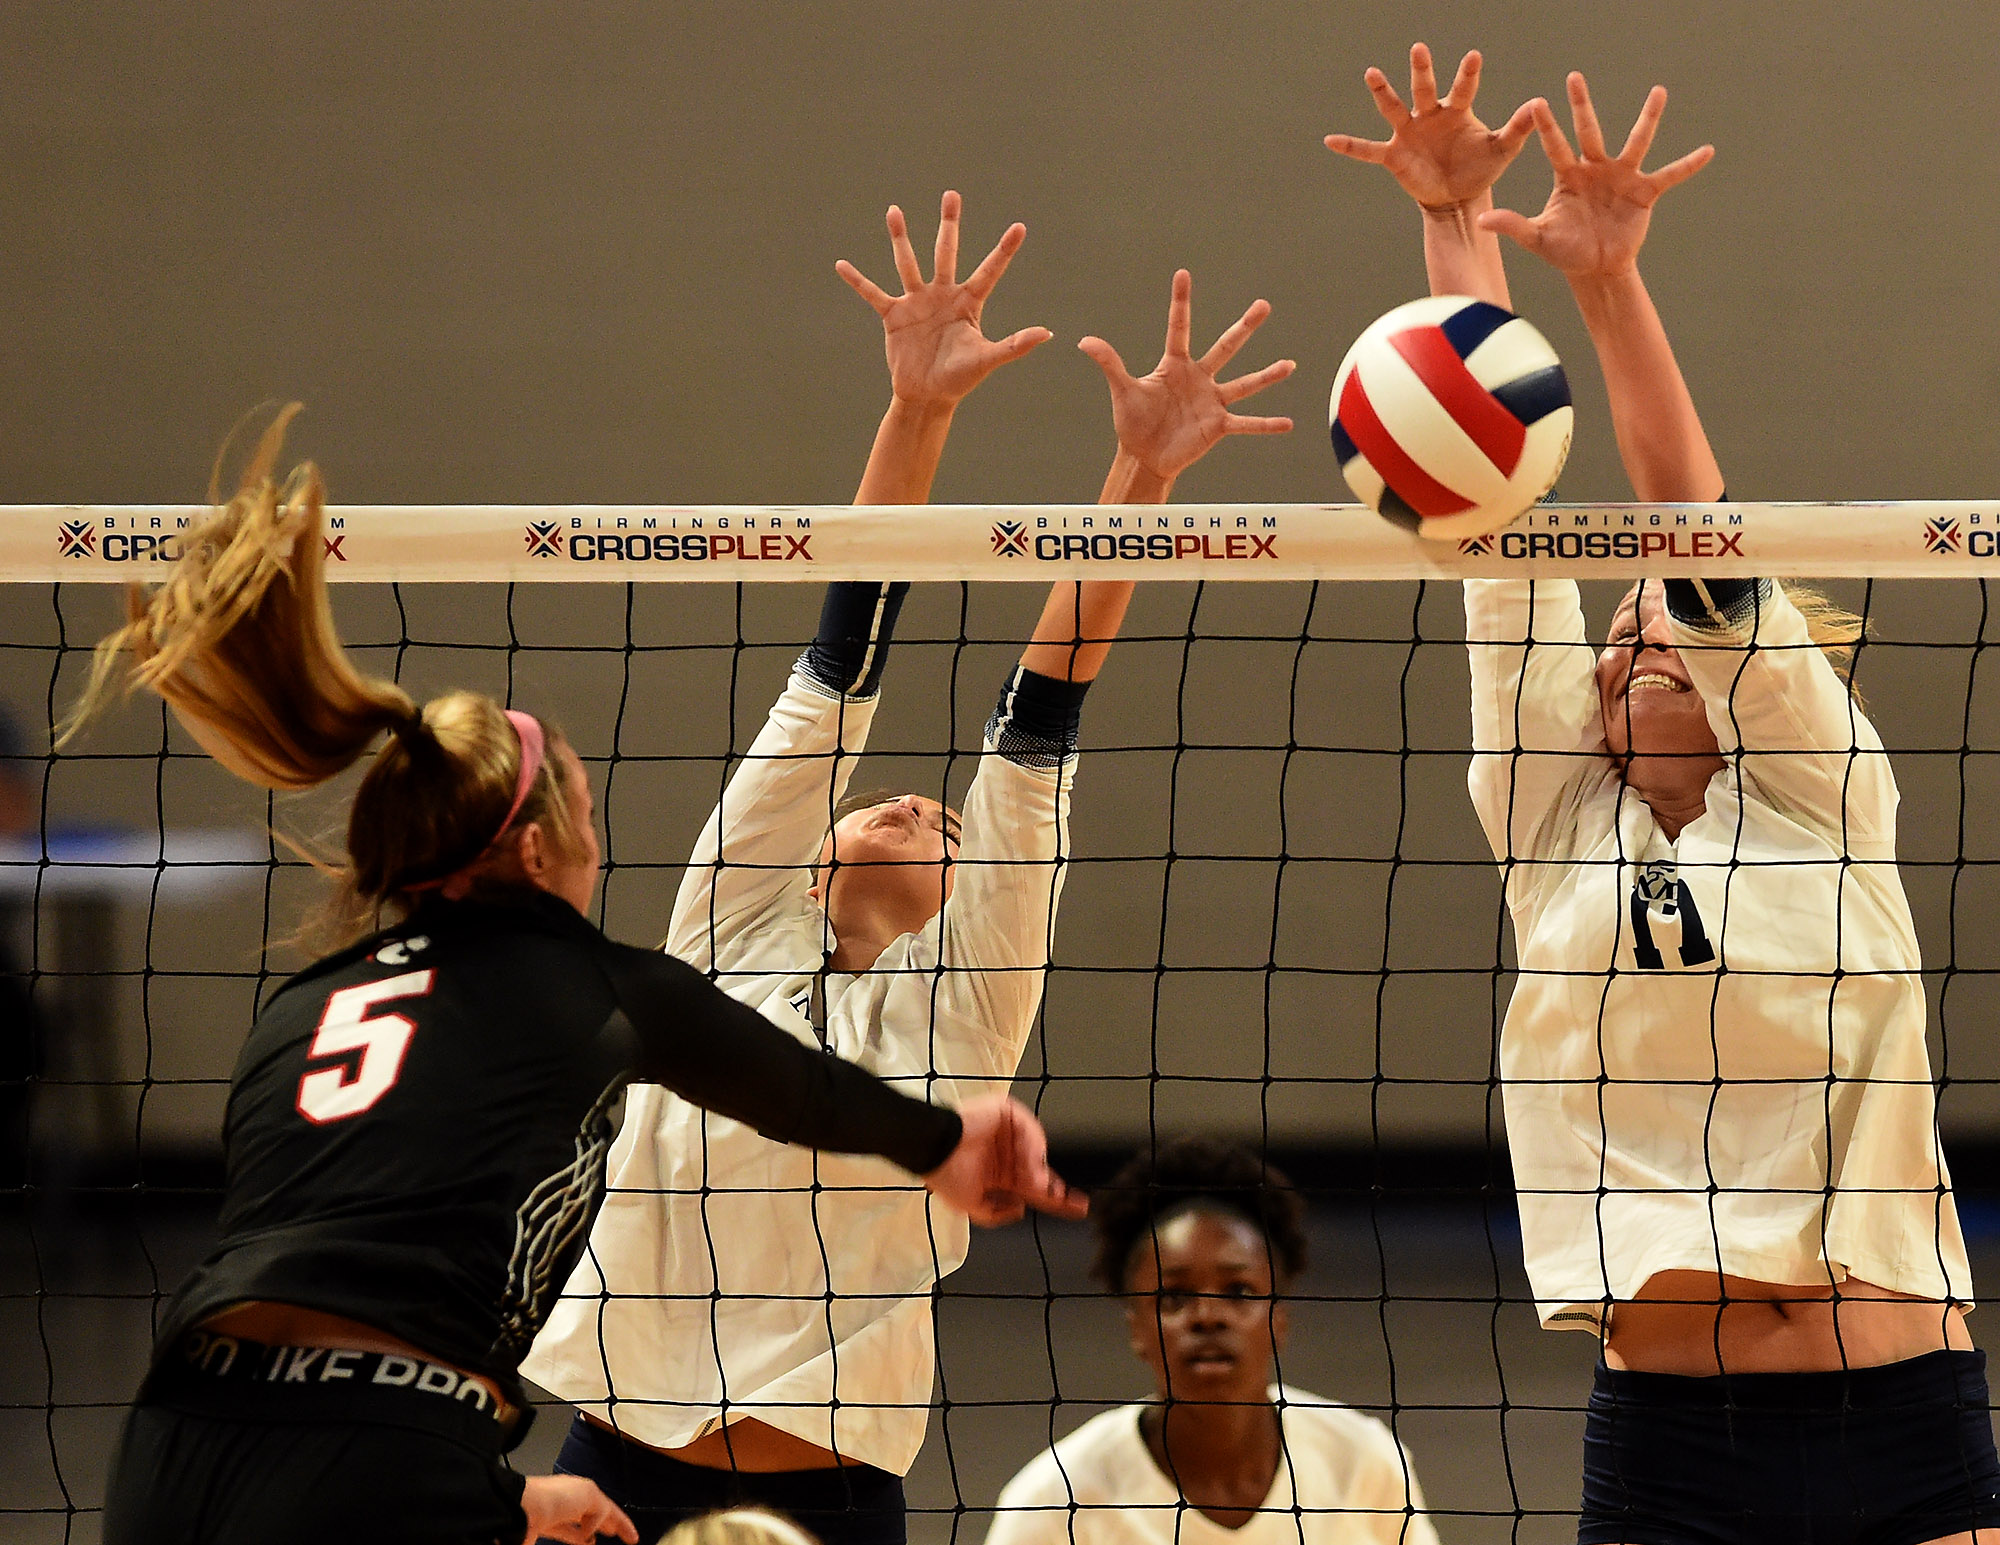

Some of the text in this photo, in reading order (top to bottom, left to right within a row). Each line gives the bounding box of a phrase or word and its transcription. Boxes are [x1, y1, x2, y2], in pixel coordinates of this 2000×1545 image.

[104, 517, 345, 529] BIRMM
[571, 517, 811, 529] BIRMINGHAM
[1036, 516, 1276, 529] BIRMINGHAM
[1528, 514, 1742, 527] IRMINGHAM
[569, 534, 814, 562] CROSSPLEX
[1035, 533, 1279, 561] CROSSPLEX
[1500, 531, 1745, 560] CROSSPLEX
[296, 967, 438, 1124] 5
